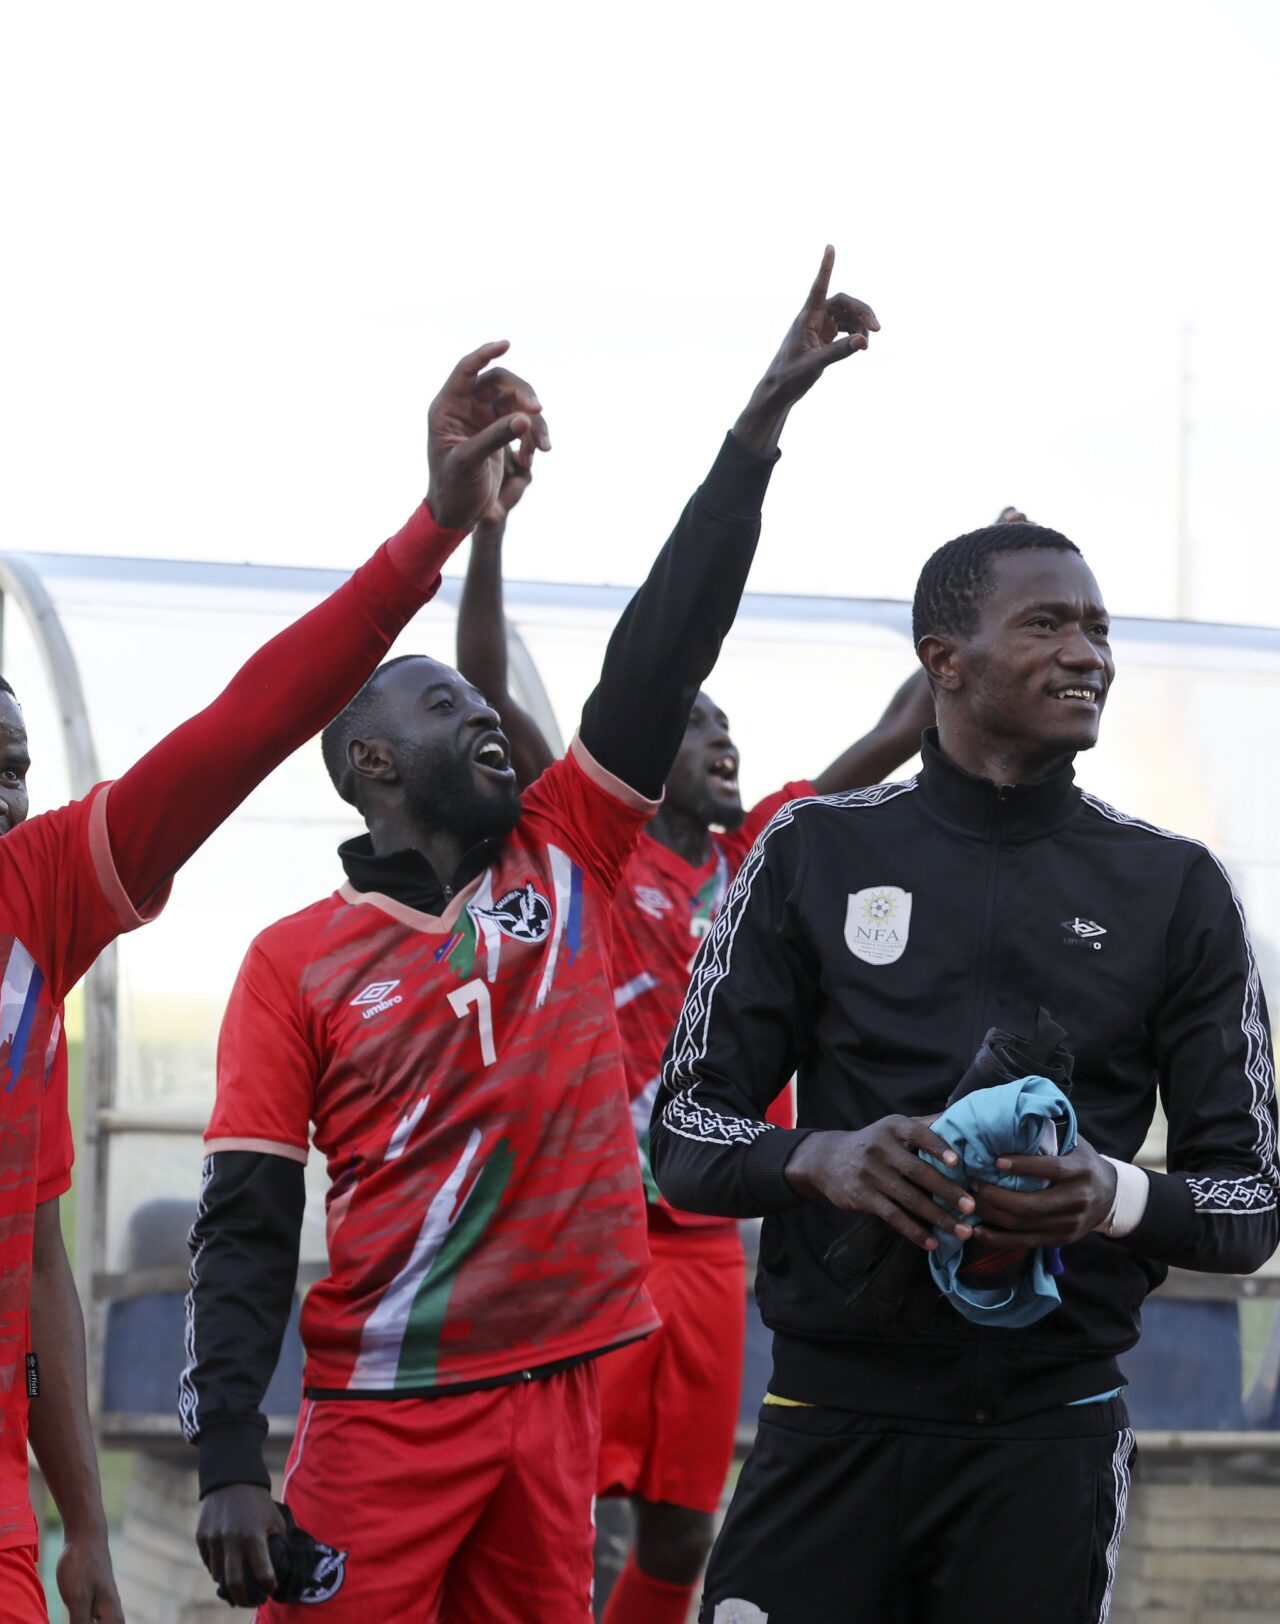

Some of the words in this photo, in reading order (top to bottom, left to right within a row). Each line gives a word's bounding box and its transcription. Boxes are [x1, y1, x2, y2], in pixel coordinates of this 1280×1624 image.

[495, 890, 522, 910] NAMIBIA
[856, 925, 900, 942] NFA
[362, 995, 403, 1019] umbro
[446, 977, 497, 1067] 7
[30, 1369, 38, 1396] official
